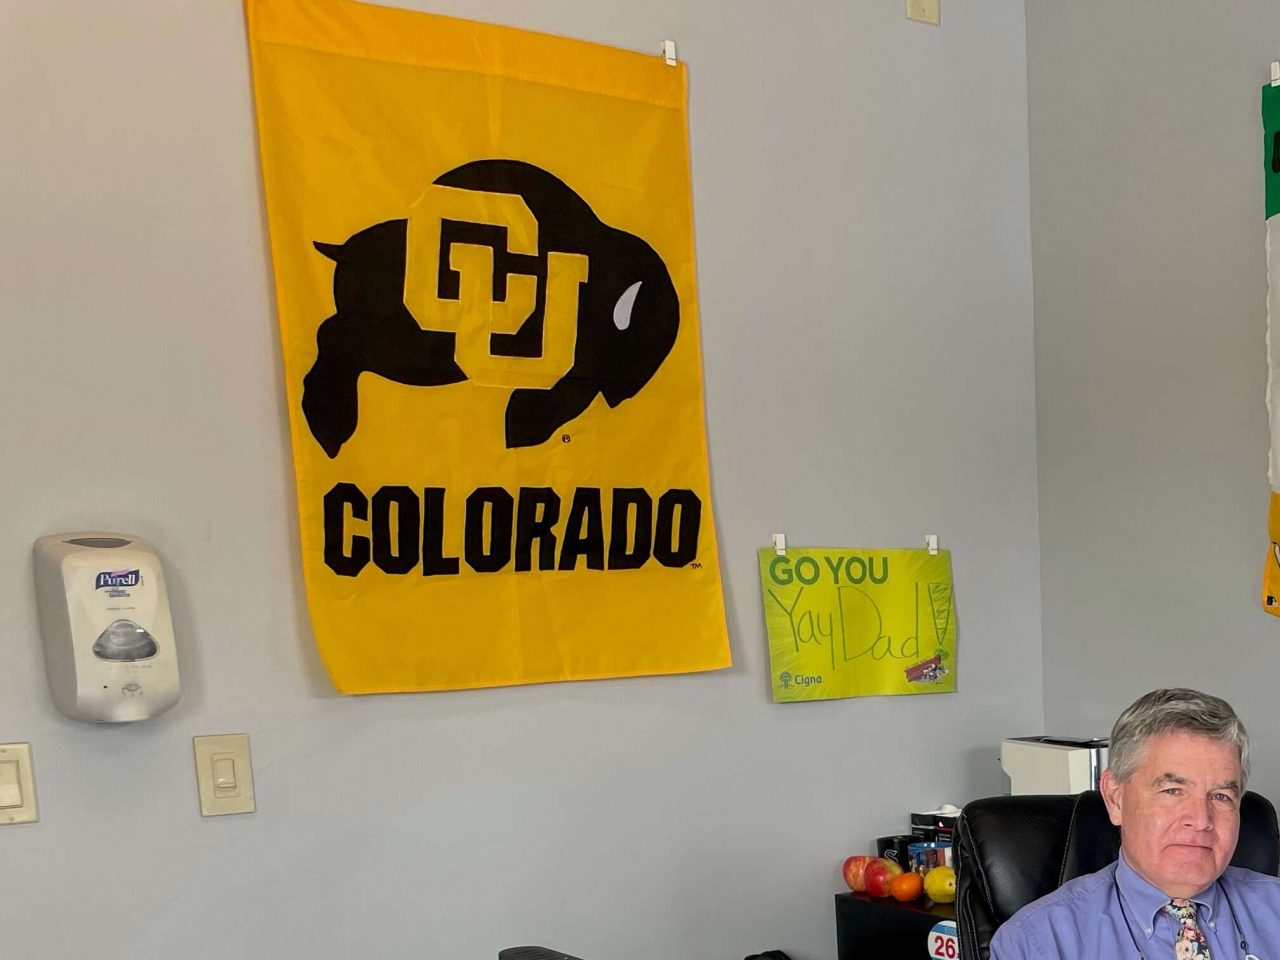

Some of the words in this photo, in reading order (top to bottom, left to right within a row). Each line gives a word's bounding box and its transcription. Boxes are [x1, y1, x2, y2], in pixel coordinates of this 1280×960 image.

[403, 184, 589, 389] CU
[323, 482, 702, 577] COLORADO
[769, 556, 820, 585] GO
[824, 556, 889, 584] YOU
[768, 586, 835, 671] Yay
[794, 673, 822, 687] Cigna
